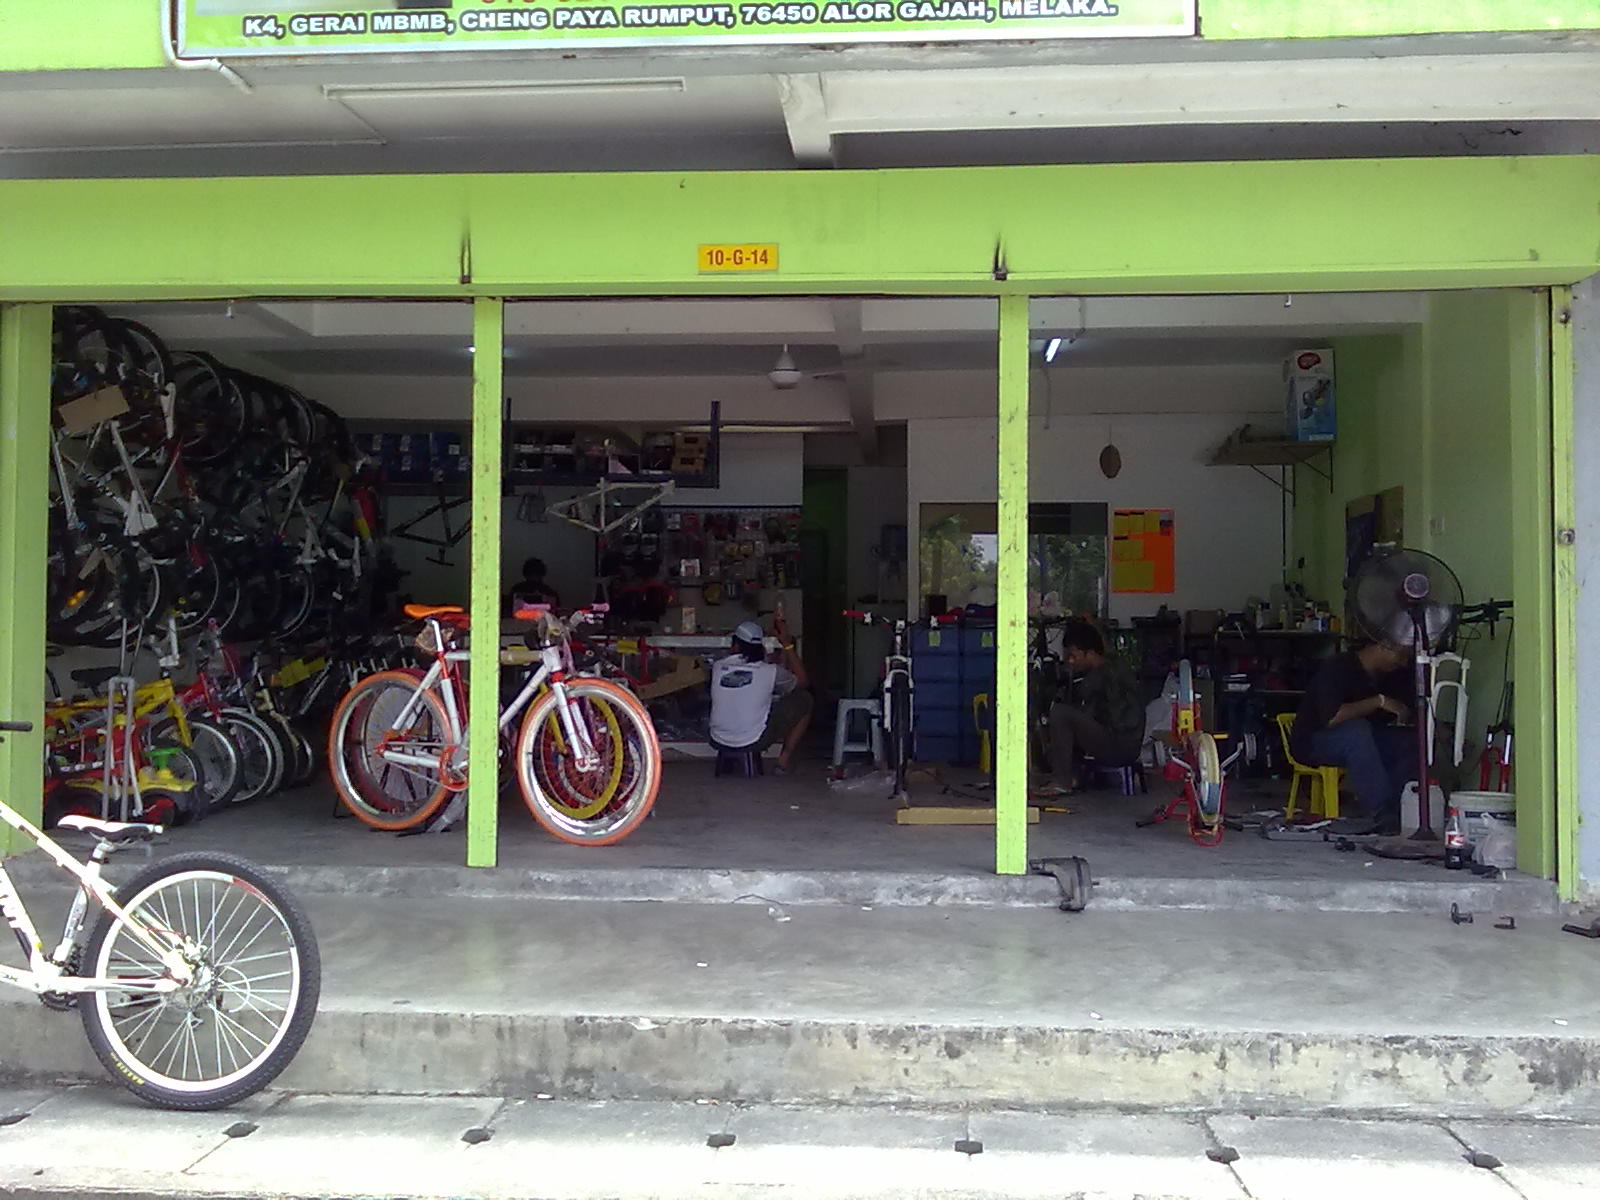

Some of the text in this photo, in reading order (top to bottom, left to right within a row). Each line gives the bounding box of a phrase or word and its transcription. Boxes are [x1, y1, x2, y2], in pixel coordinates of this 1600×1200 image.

[243, 0, 1117, 37] K4, GERAI MBMB, CHENG PAYA RUMPUT, 76450 ALOR GAJAH, MELAKA.
[706, 248, 769, 266] 10-G-14
